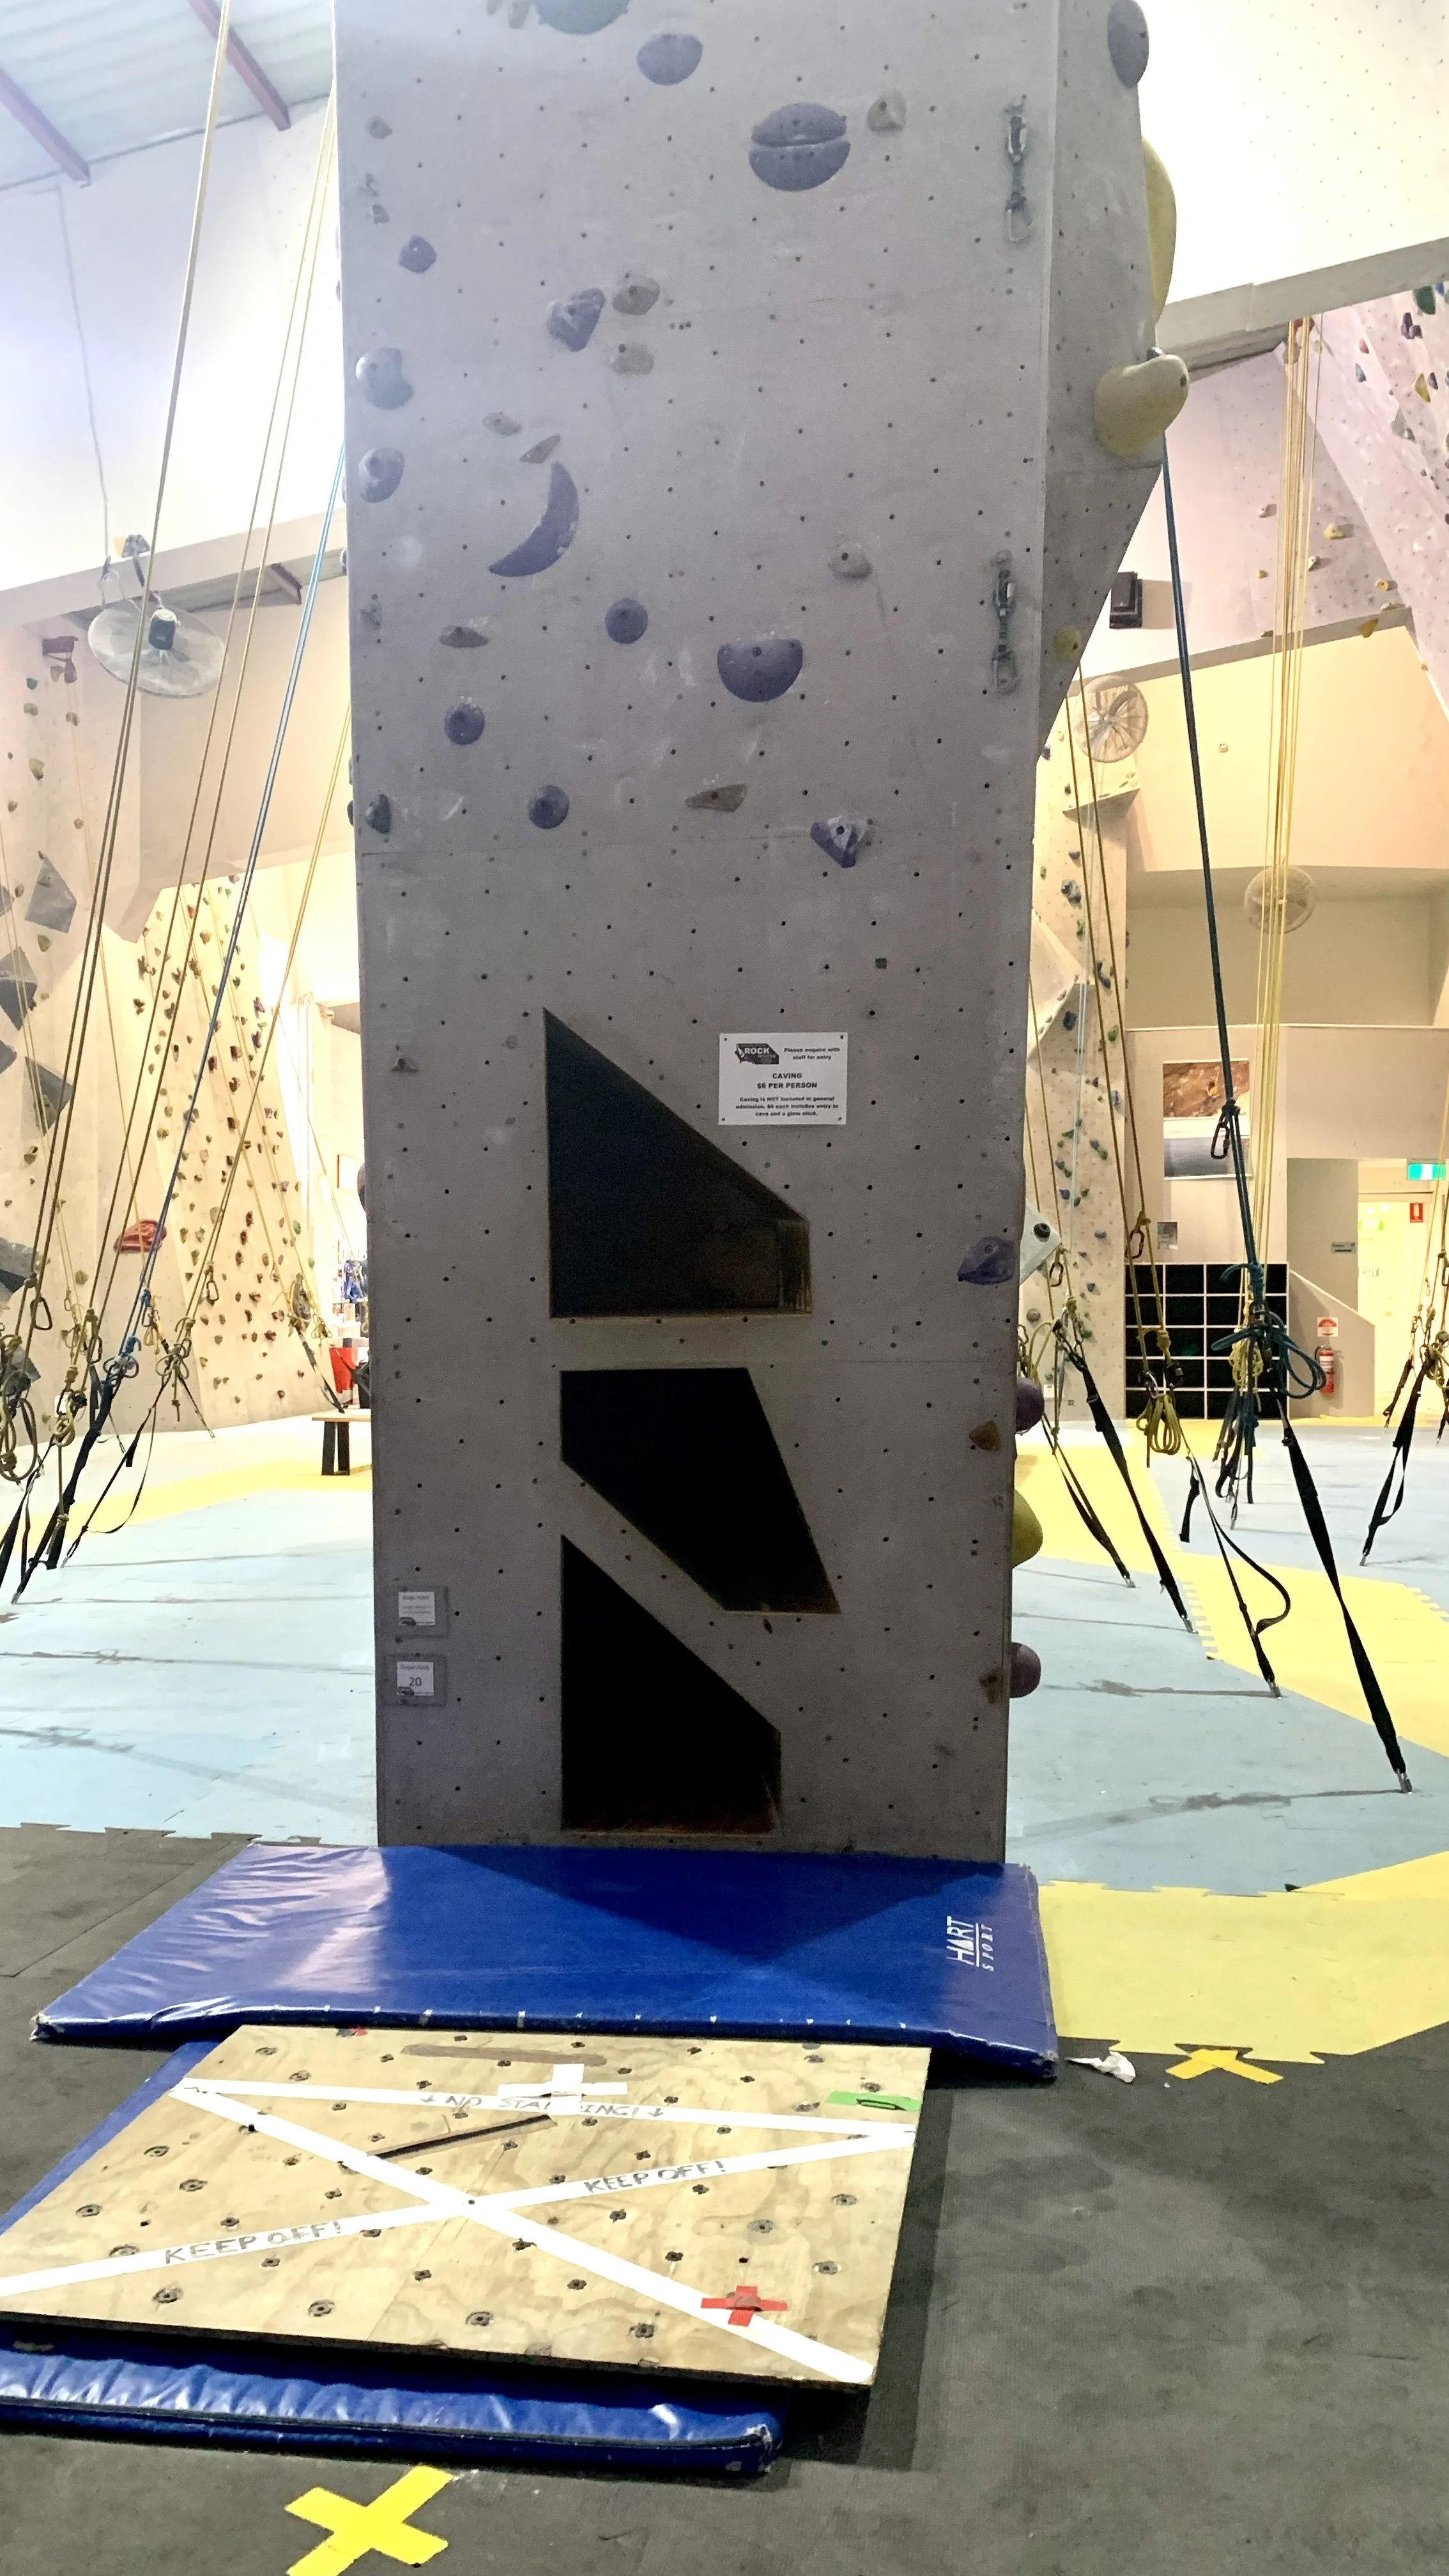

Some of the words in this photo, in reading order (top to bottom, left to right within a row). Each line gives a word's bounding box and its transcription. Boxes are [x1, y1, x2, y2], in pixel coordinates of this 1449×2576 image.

[409, 1676, 422, 1687] 20
[946, 1915, 974, 1966] HART
[981, 1924, 994, 1972] SPORT
[445, 2096, 482, 2110] NO
[583, 2172, 649, 2193] KEEP
[657, 2160, 726, 2180] OFF!
[165, 2235, 257, 2264] KEEP
[267, 2220, 341, 2244] OFF!
